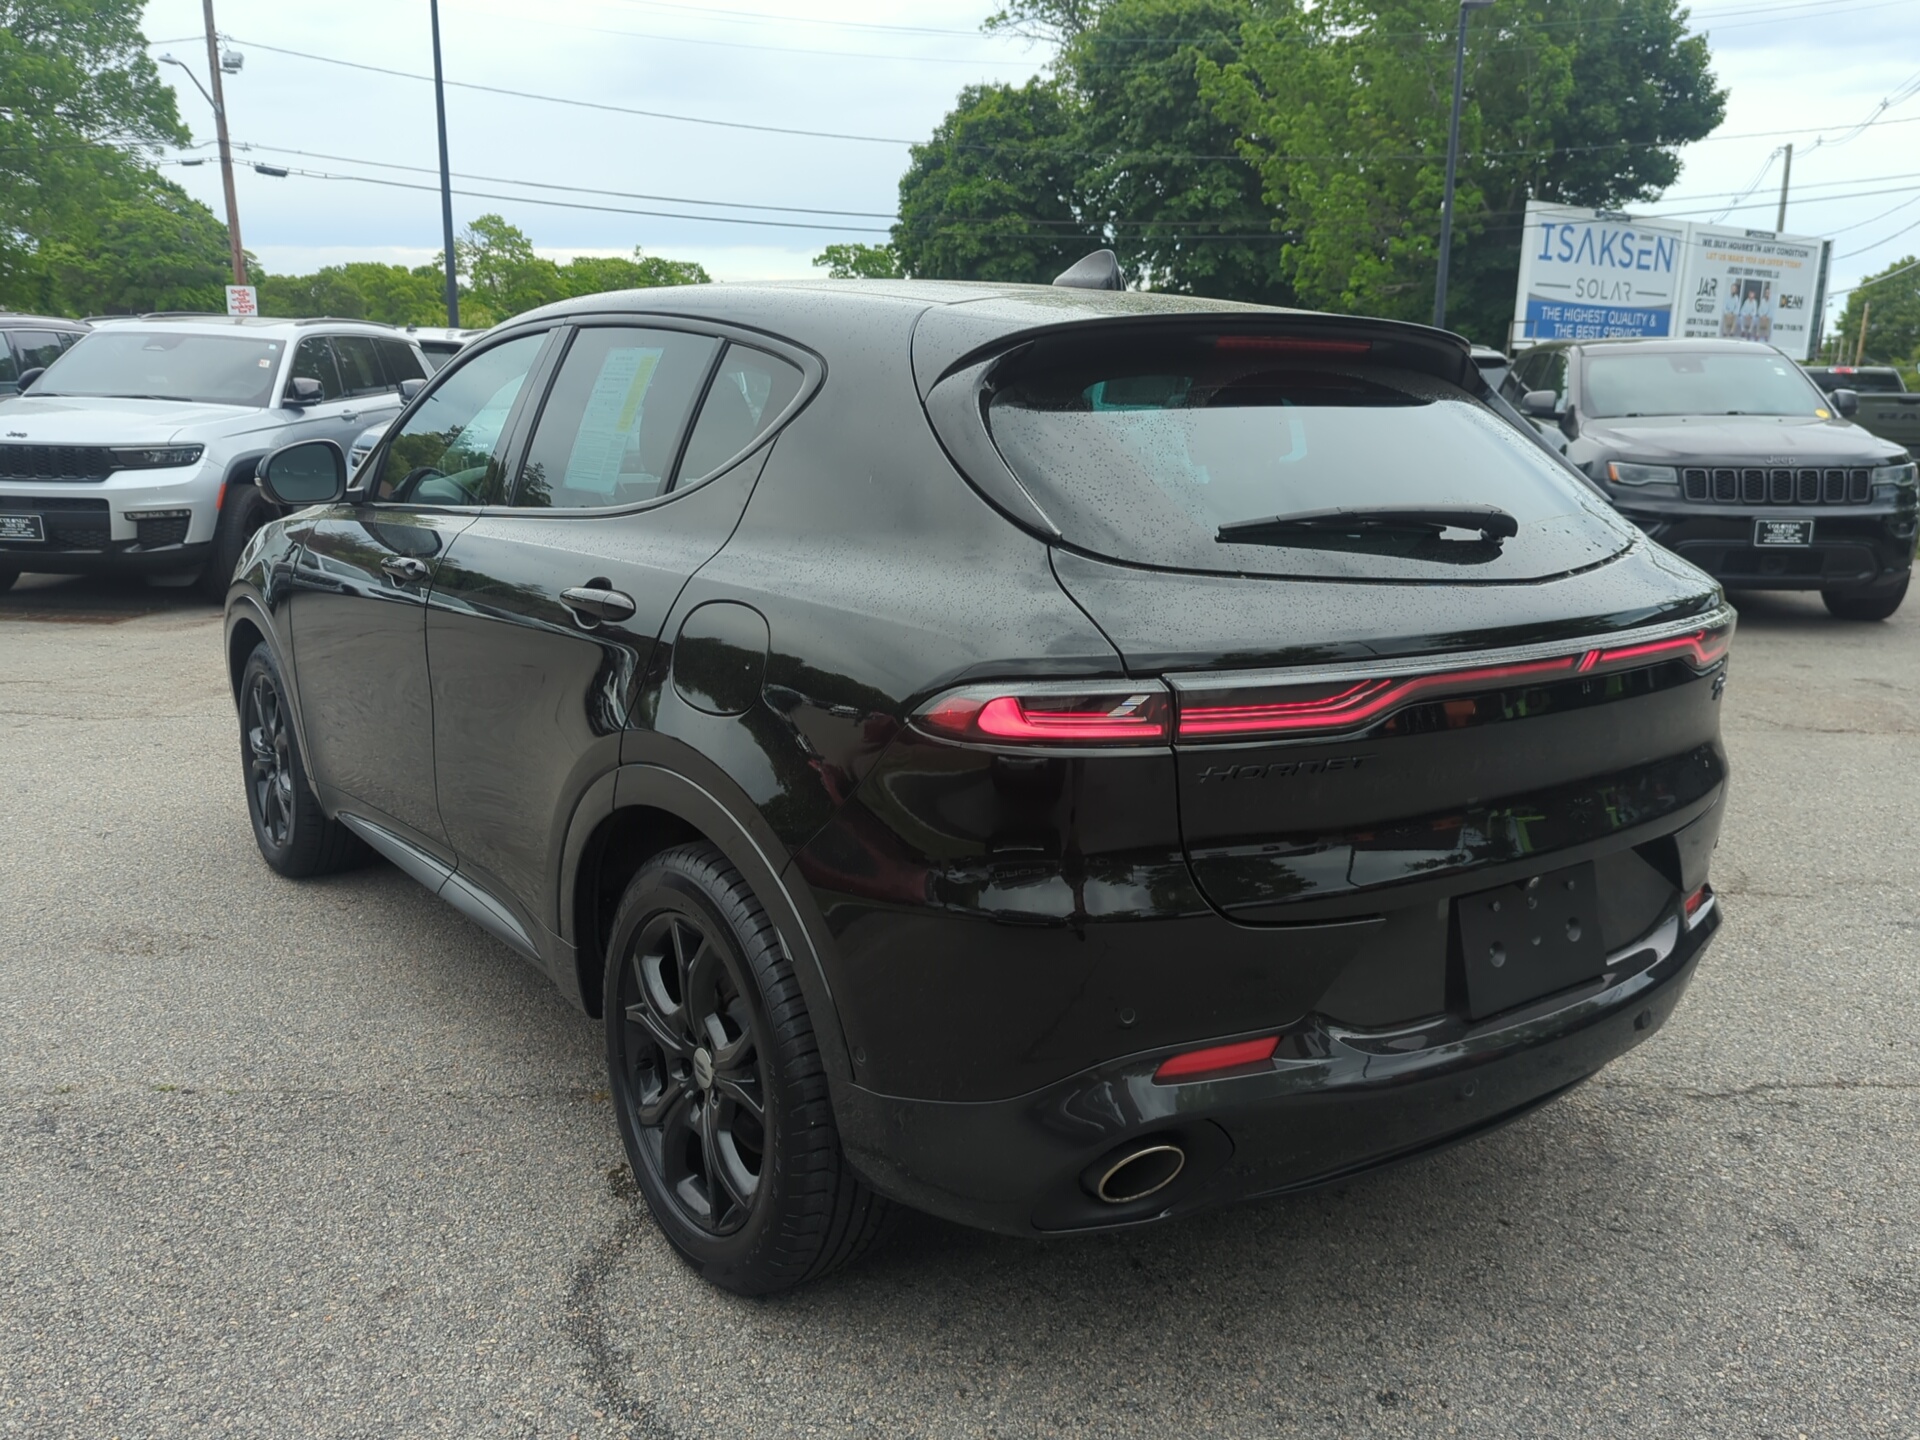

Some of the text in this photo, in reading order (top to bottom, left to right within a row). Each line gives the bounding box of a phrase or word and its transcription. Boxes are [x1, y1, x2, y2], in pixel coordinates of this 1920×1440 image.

[1538, 222, 1675, 273] ISAKSEN
[1702, 238, 1809, 259] WE BUY HOUSES IN ANY CONDITION
[1575, 277, 1632, 302] SOLAR
[1696, 276, 1718, 297] JAR
[1541, 306, 1657, 327] THE HIGHEST QUALITY &
[1554, 323, 1643, 339] THE BEST SERVICE
[1877, 412, 1918, 421] RA
[1764, 455, 1796, 465] Jeep
[1197, 753, 1379, 784] HORNET
